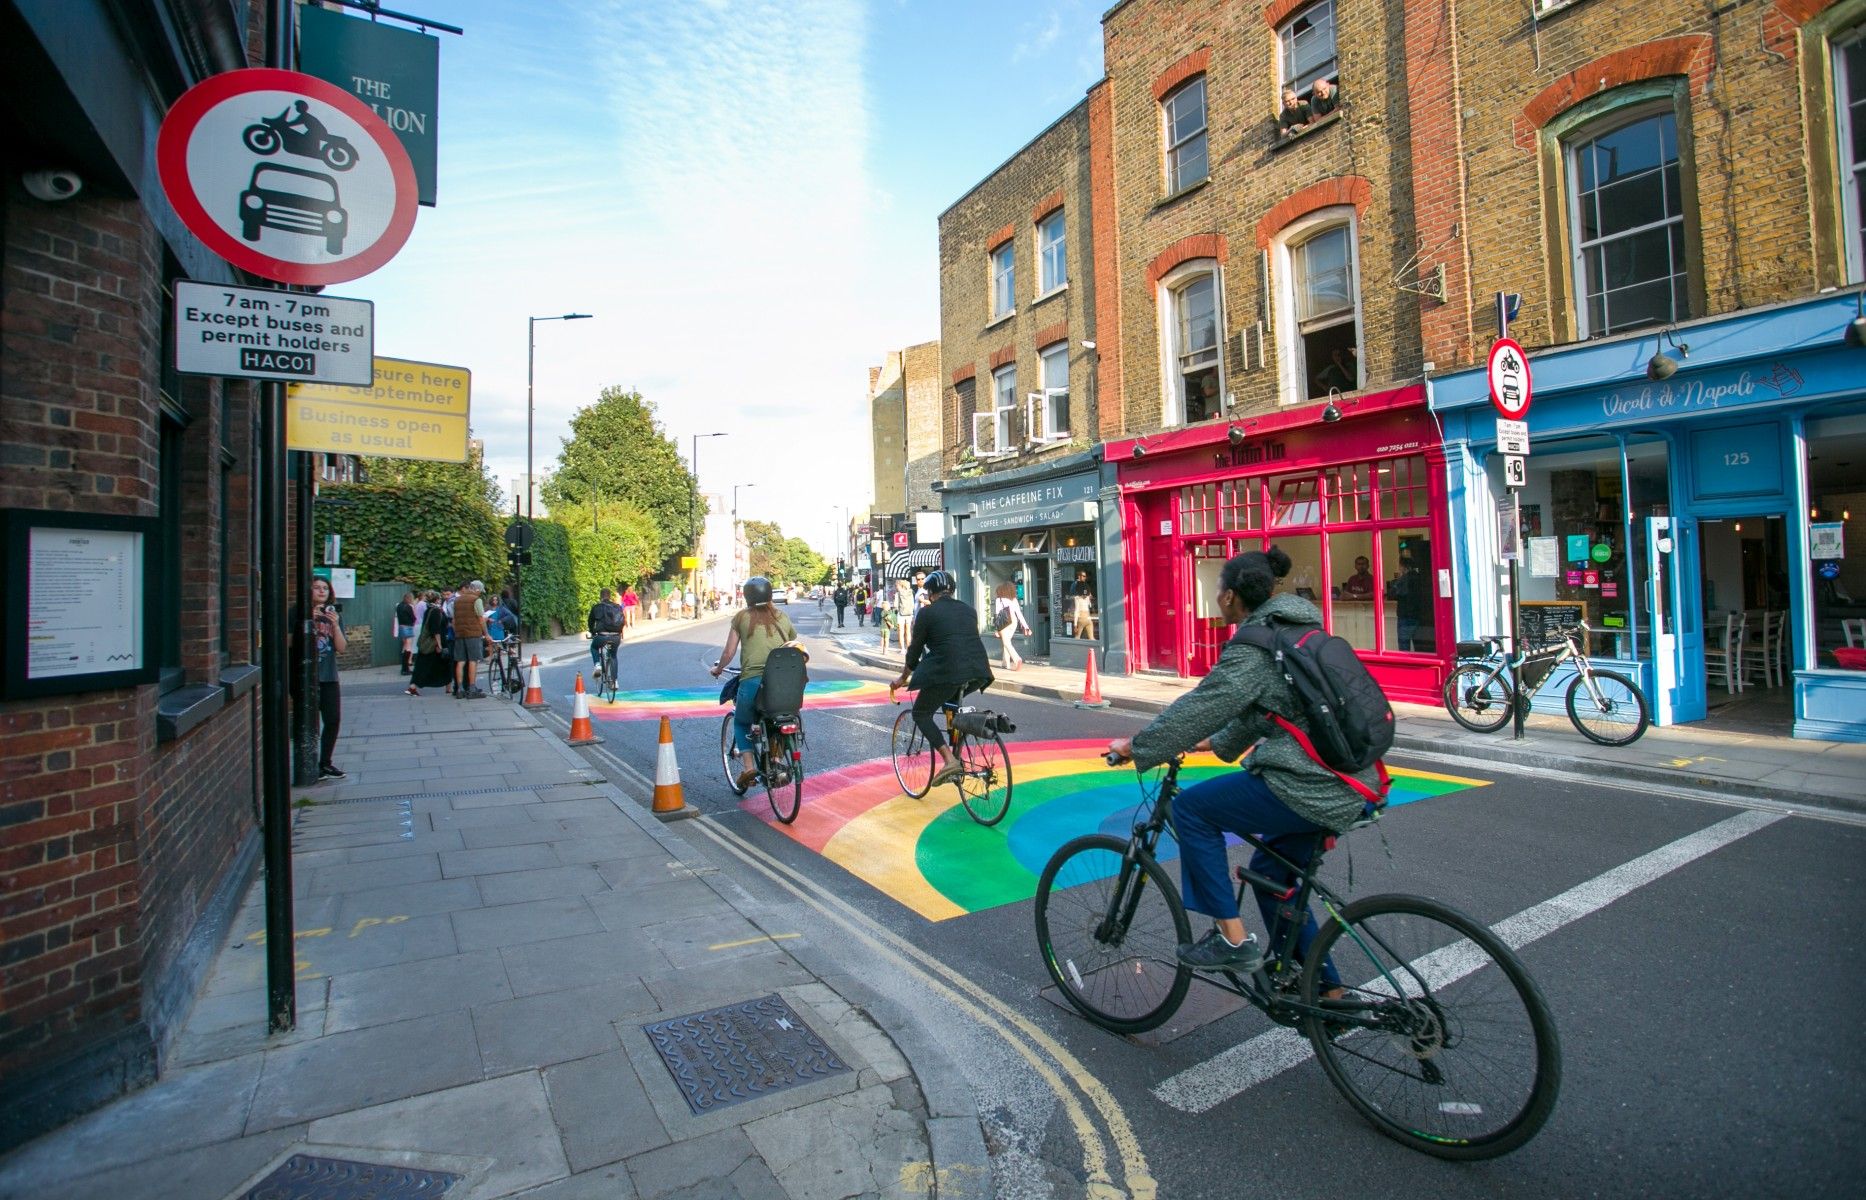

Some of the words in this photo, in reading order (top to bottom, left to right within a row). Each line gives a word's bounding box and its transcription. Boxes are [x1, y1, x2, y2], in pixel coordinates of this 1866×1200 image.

[352, 76, 391, 100] THE
[186, 307, 260, 328] Except
[266, 315, 324, 334] buses
[330, 325, 364, 337] and
[201, 330, 271, 347] permit
[278, 334, 351, 353] holders
[374, 368, 415, 383] sure
[421, 371, 462, 389] here
[1681, 371, 1755, 407] Napoli
[300, 406, 390, 429] Business
[396, 419, 442, 433] open
[331, 431, 352, 443] as
[361, 433, 413, 449] usual
[1724, 452, 1750, 466] 125
[981, 498, 997, 511] THE
[1000, 490, 1042, 507] CAFFEINE
[1046, 486, 1063, 500] FIX
[1083, 486, 1093, 494] 121
[980, 518, 998, 528] COFFEE
[1003, 515, 1034, 526] SANDWICH
[1039, 511, 1060, 521] SALAD
